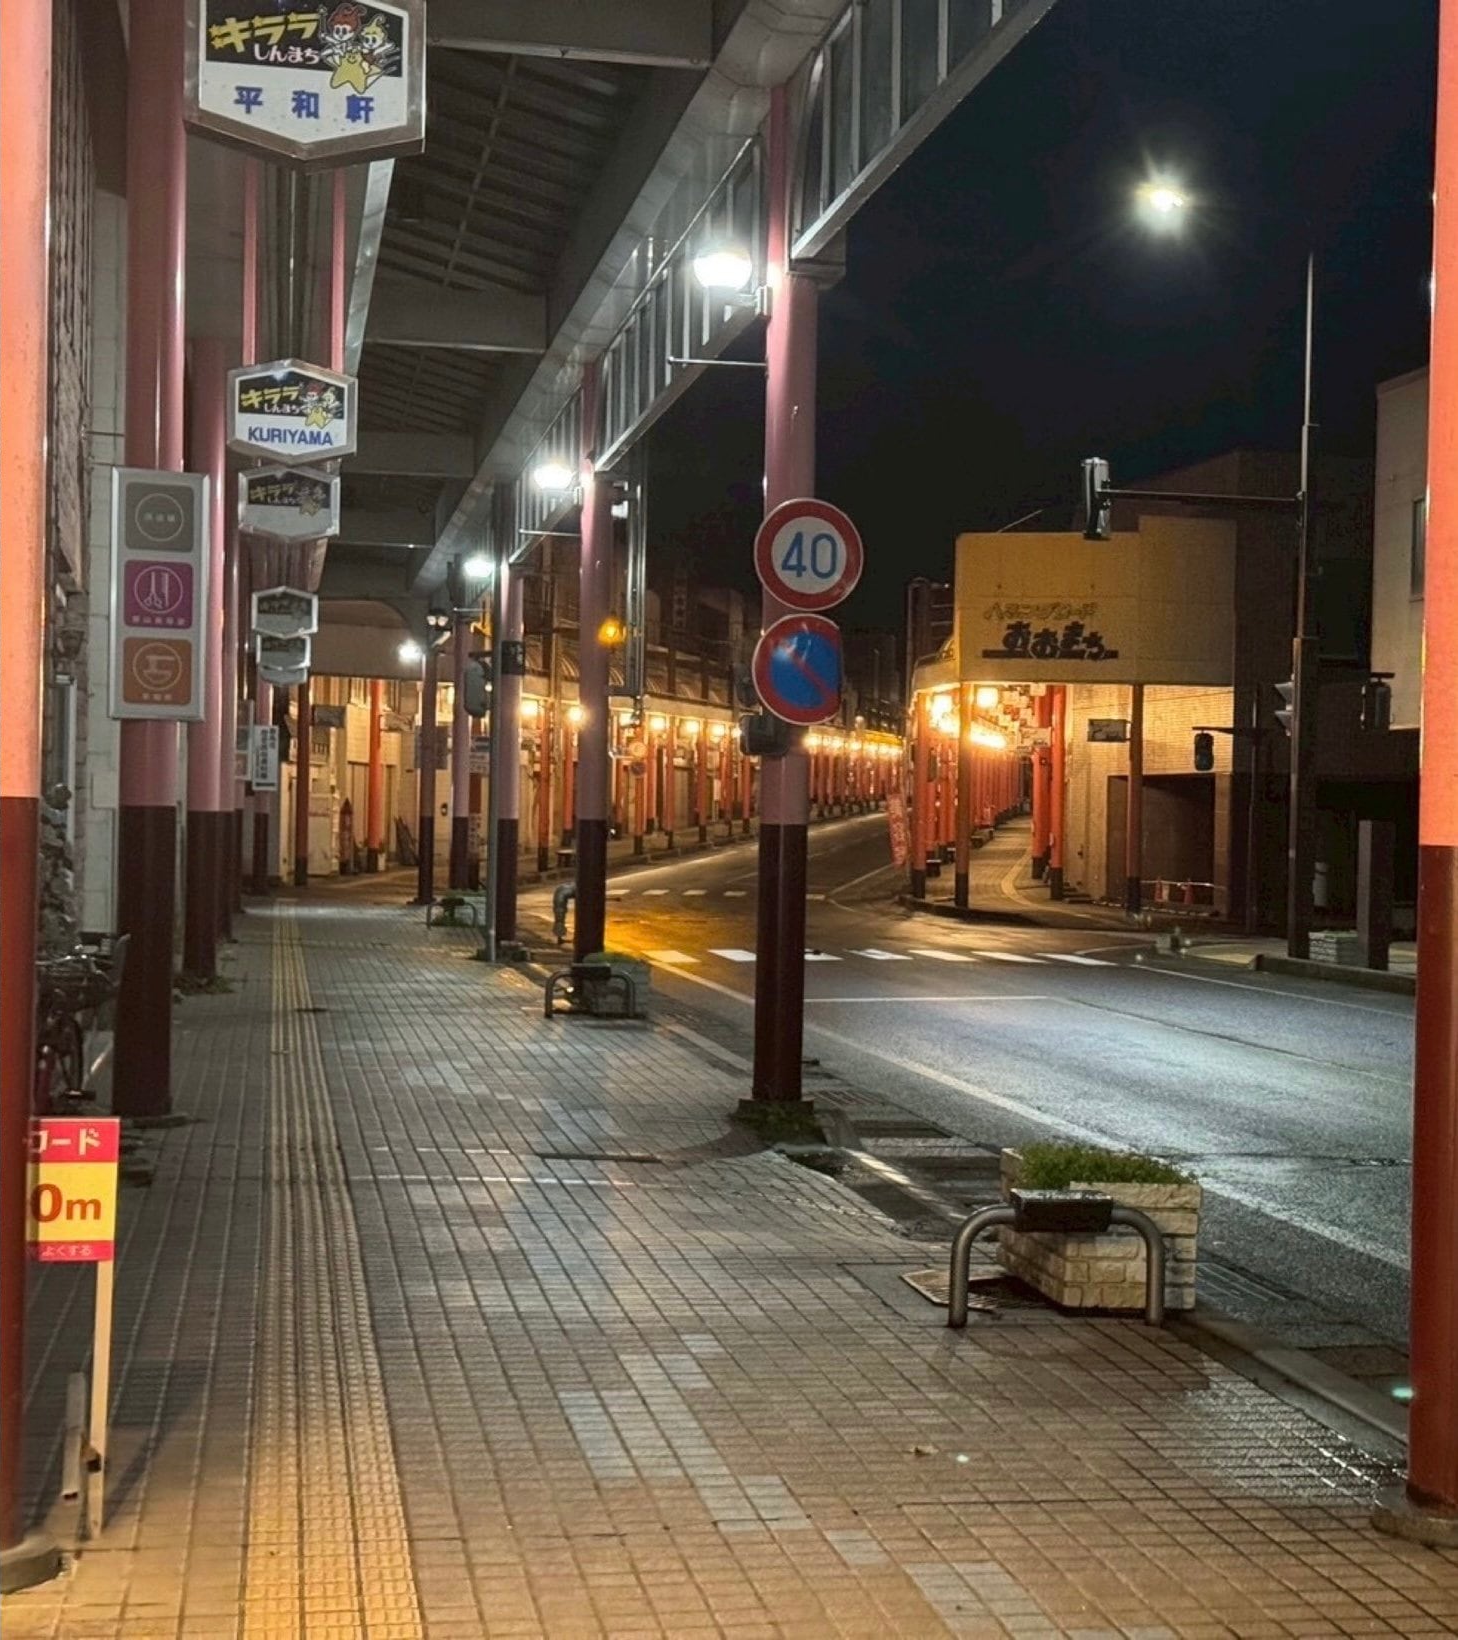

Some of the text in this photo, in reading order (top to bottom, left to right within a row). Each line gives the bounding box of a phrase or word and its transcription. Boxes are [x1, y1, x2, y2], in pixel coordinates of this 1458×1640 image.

[208, 11, 321, 53] キララ
[254, 43, 321, 65] しんまち
[234, 86, 375, 124] 平和軒
[240, 386, 301, 409] キララ
[248, 426, 334, 447] KURIYAMA
[781, 531, 838, 579] 40
[28, 1244, 93, 1257] よくする
